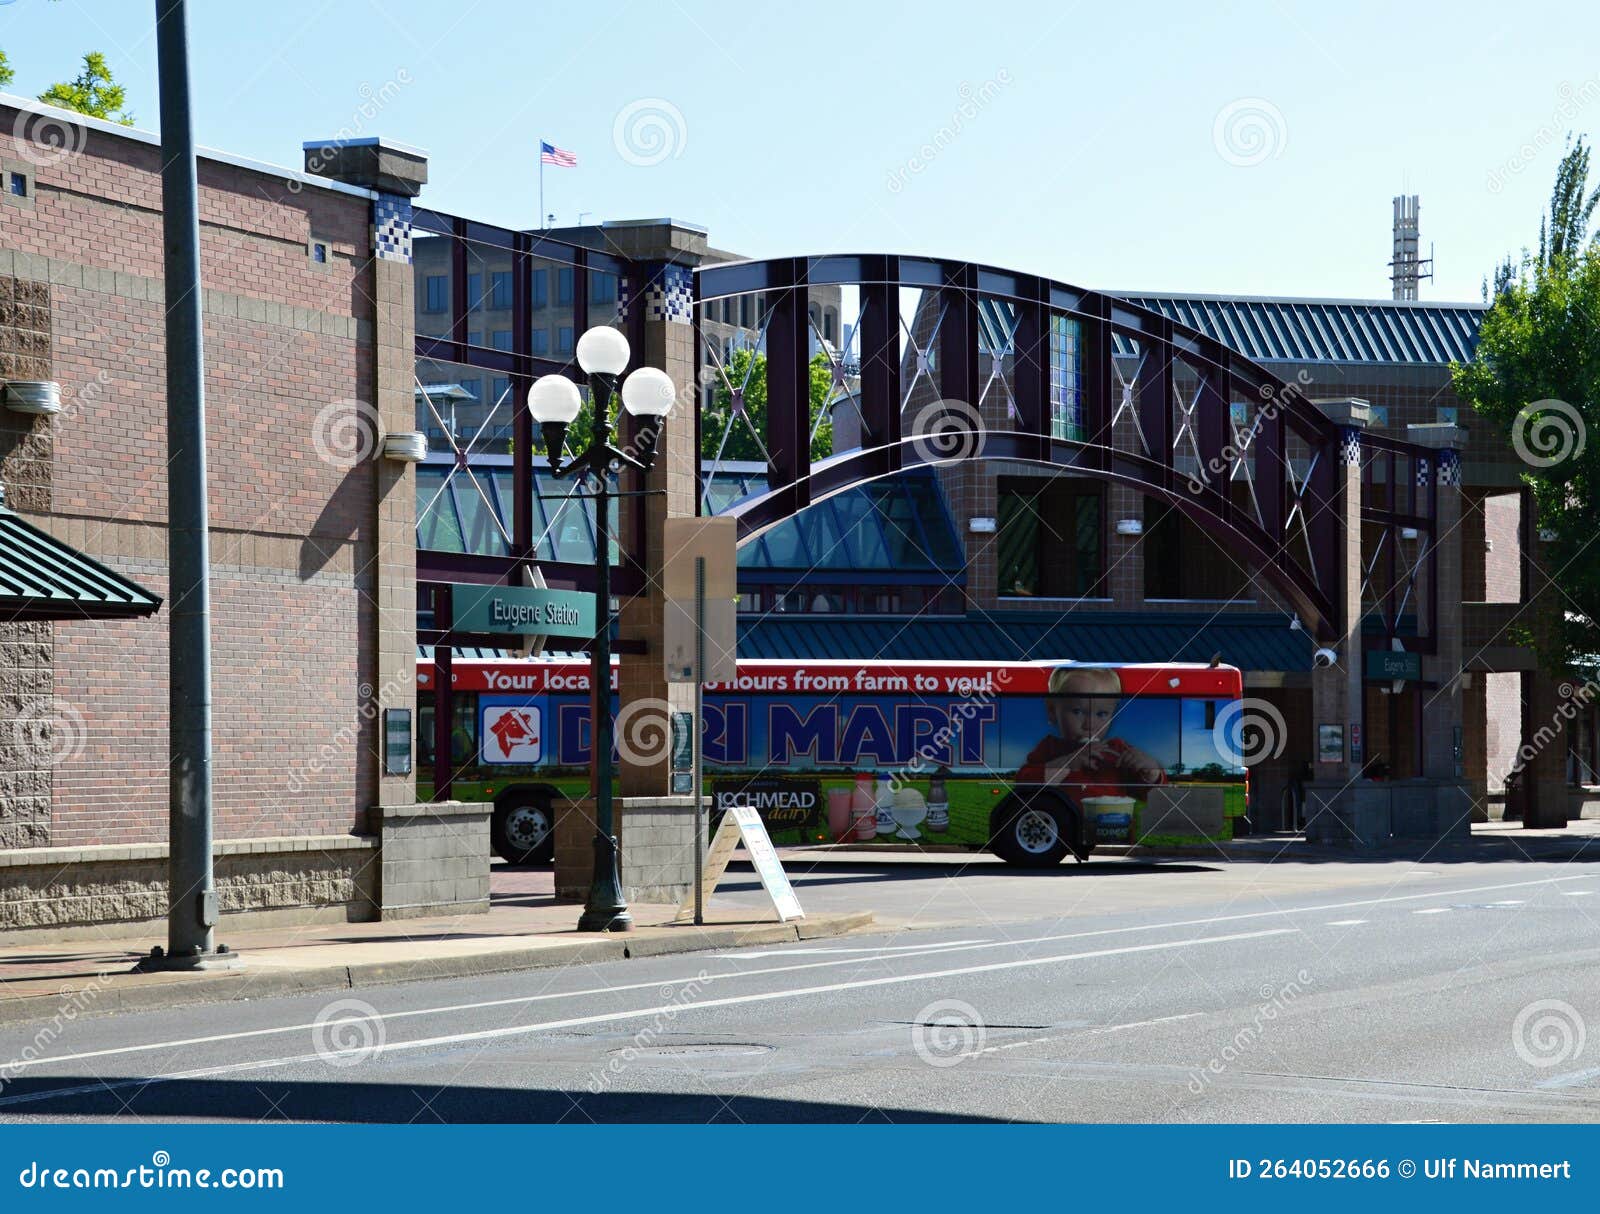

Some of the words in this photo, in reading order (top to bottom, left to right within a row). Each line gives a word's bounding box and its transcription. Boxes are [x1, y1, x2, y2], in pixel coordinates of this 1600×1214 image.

[494, 598, 541, 626] Eugene
[546, 601, 580, 625] Station
[482, 670, 537, 690] Your
[543, 669, 591, 690] loca
[793, 669, 849, 690] from
[854, 669, 908, 690] farm
[914, 673, 939, 690] to
[944, 671, 993, 692] you!
[768, 702, 997, 767] MART
[717, 791, 816, 810] LOCHMEAD
[767, 804, 812, 824] dairy
